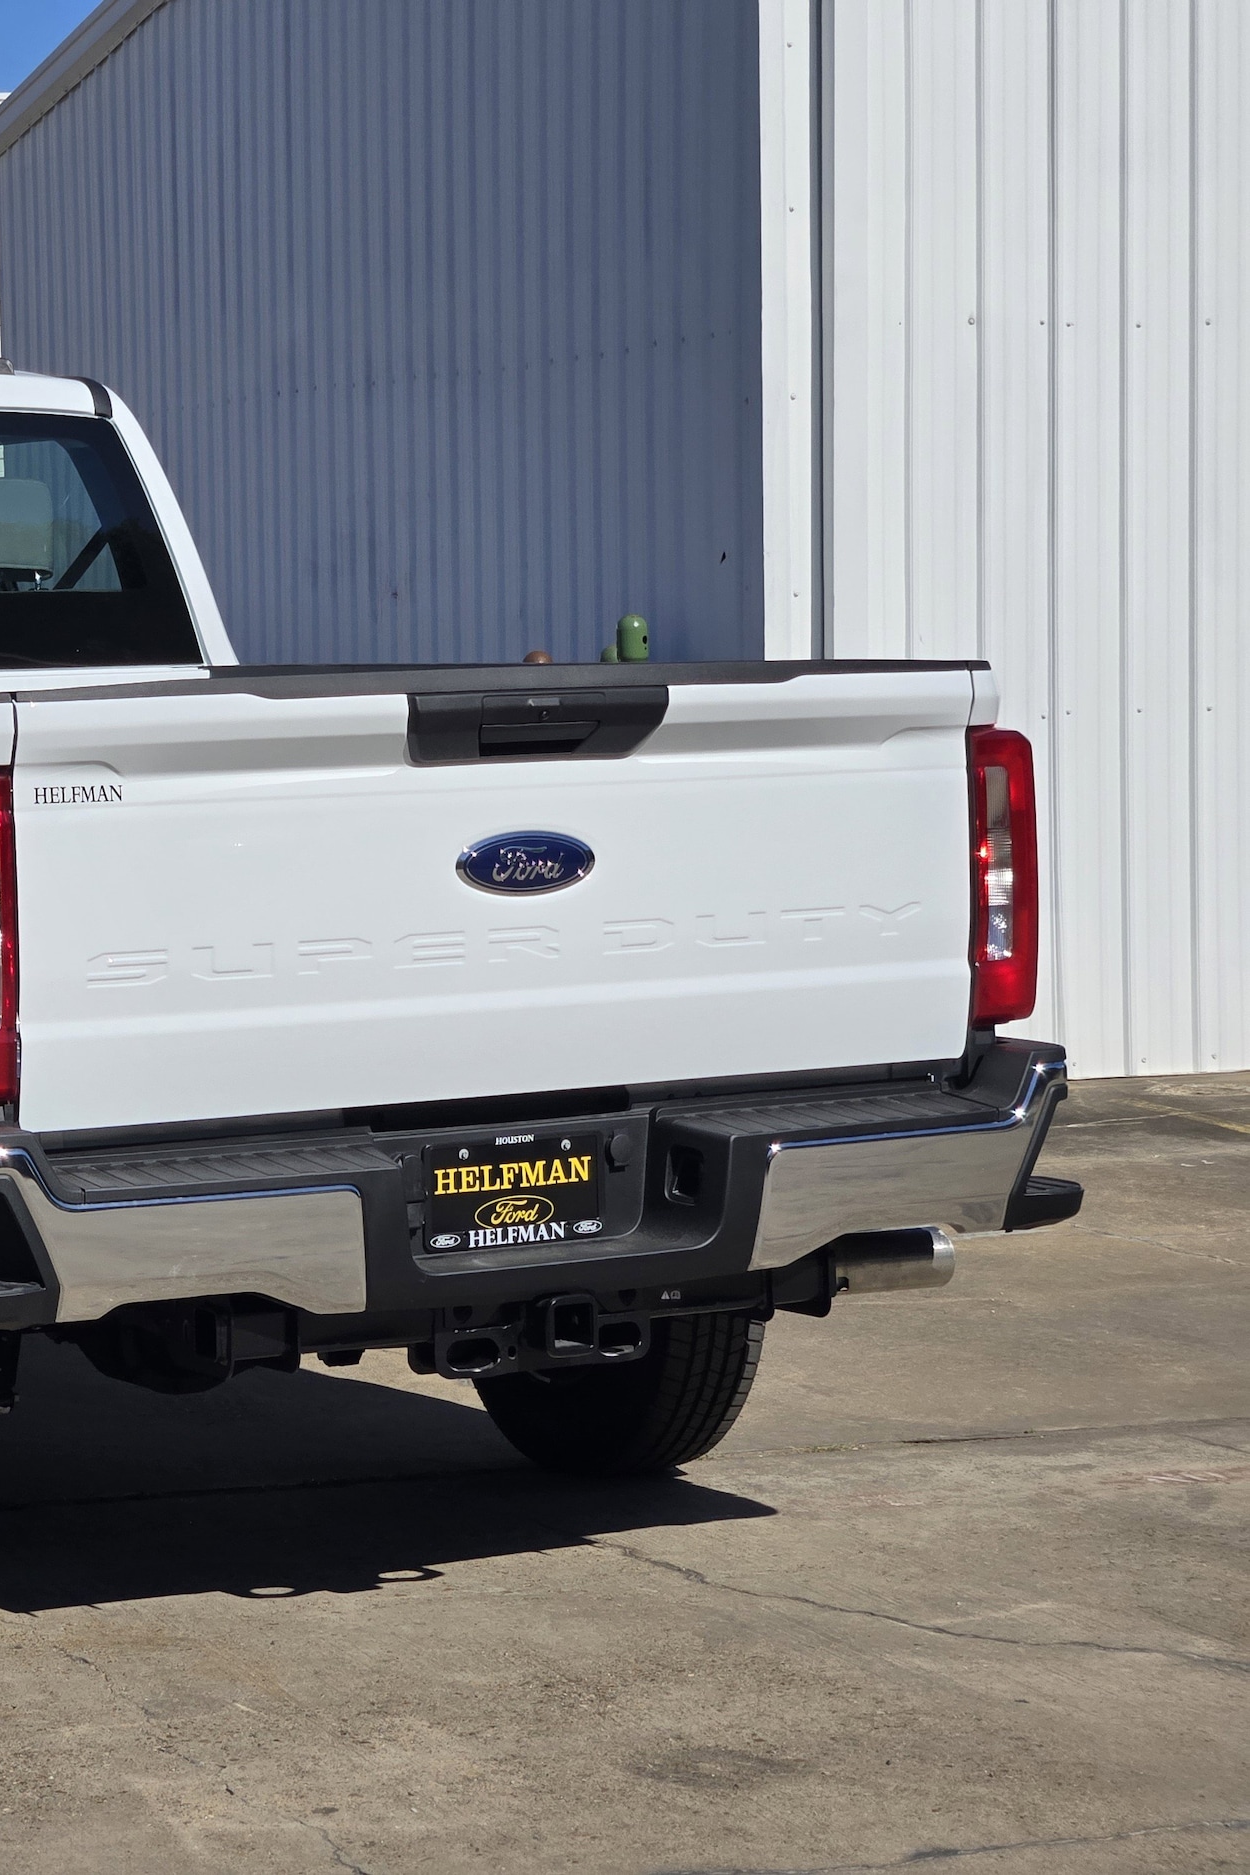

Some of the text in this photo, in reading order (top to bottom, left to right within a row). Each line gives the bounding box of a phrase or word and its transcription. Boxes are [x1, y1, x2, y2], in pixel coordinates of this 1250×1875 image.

[33, 784, 123, 804] HELFMAN
[492, 845, 565, 882] Ford
[86, 901, 923, 989] SUPER DUTY
[495, 1134, 535, 1146] HOUSTON
[433, 1155, 592, 1195] HELFMAN
[490, 1199, 540, 1225] Ford
[468, 1222, 566, 1248] HELFMAN
